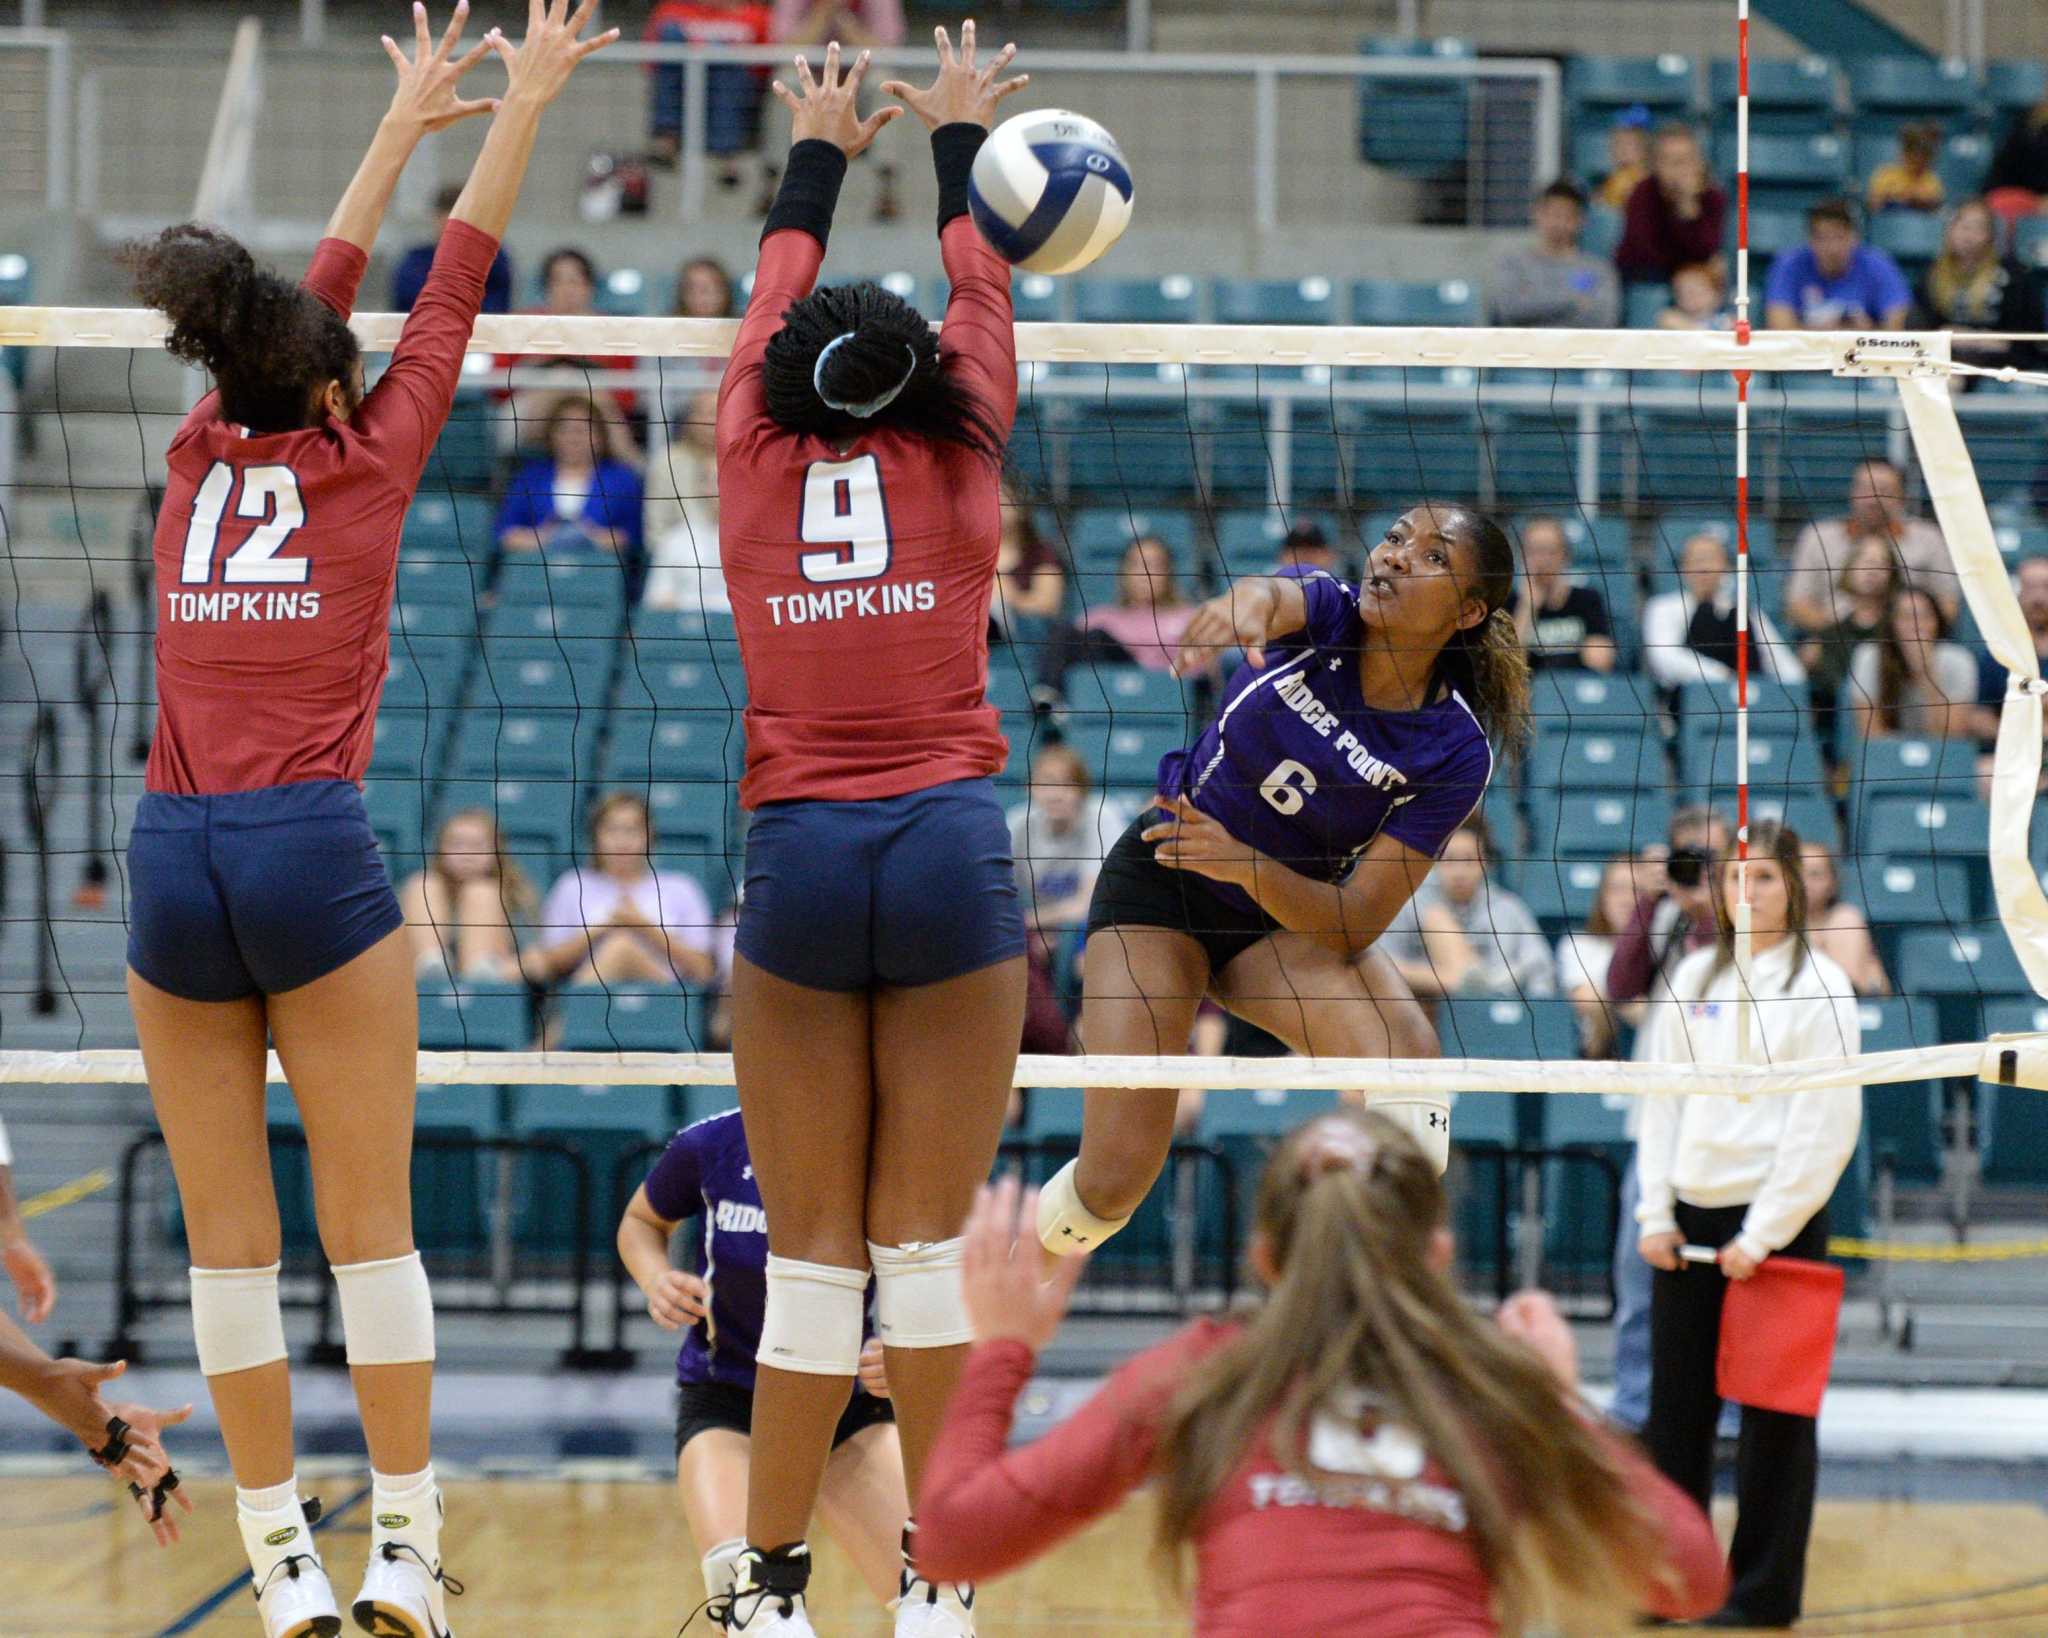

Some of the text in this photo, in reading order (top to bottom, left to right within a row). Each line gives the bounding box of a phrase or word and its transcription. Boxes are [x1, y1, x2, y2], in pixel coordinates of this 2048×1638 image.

[180, 459, 312, 585] 12
[798, 453, 892, 583] 9
[167, 591, 321, 622] TOMPKINS
[766, 580, 936, 626] TOMPKINS
[1259, 758, 1318, 815] 6
[1333, 730, 1408, 792] POINT
